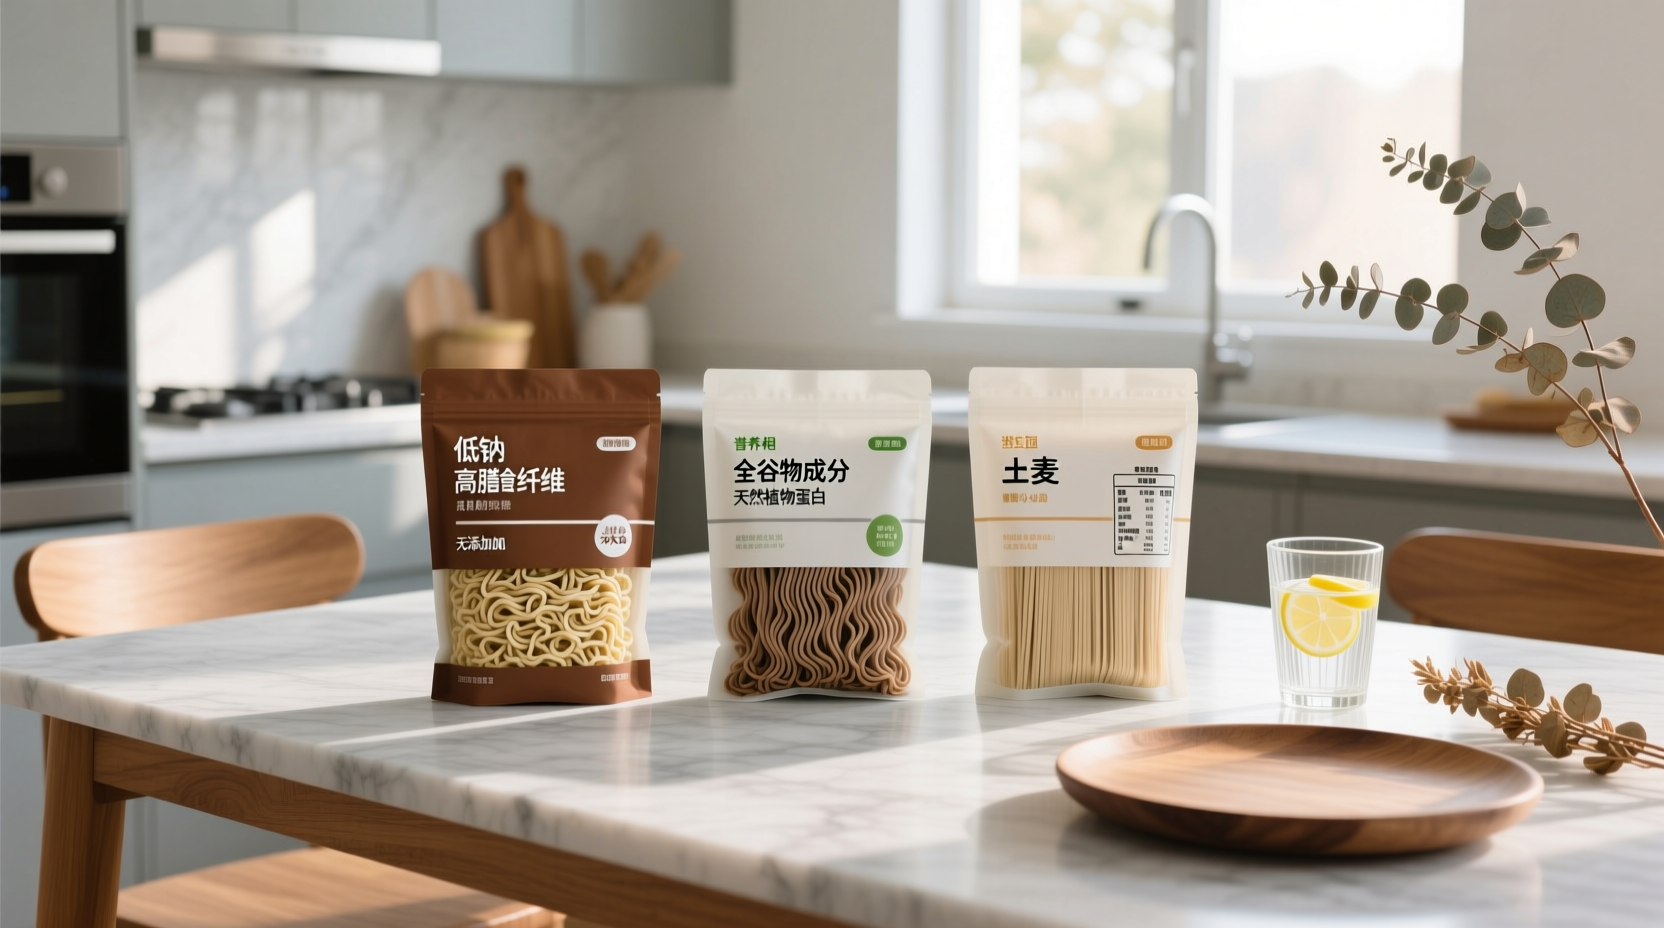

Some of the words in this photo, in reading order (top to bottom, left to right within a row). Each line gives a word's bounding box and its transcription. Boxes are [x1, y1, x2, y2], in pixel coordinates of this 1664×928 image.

[454, 435, 505, 463] 低钠
[734, 458, 850, 483] 全谷物成分
[1002, 456, 1060, 485] 土麦
[734, 487, 825, 506] 天然植物蛋白
